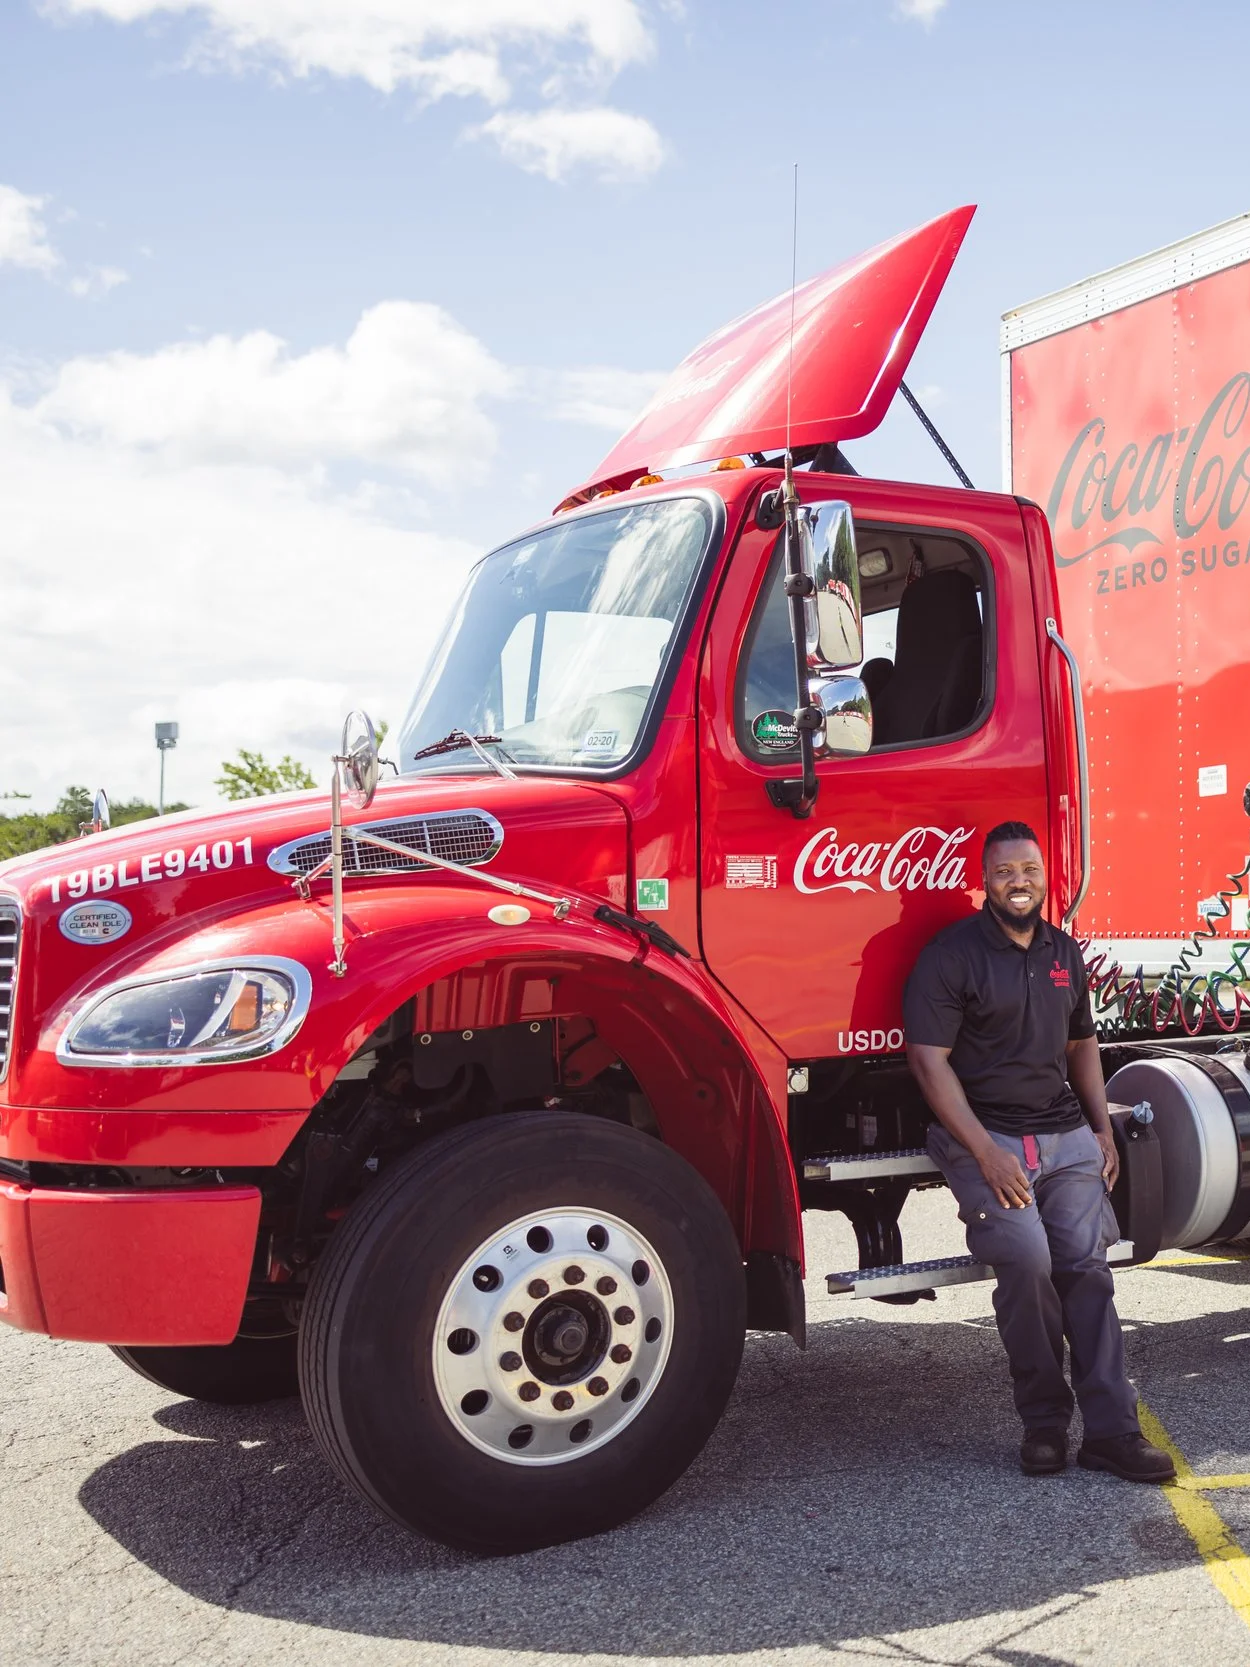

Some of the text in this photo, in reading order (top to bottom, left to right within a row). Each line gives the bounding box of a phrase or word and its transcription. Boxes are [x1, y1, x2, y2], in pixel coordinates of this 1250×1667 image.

[1096, 557, 1168, 595] ZERO
[42, 836, 254, 903] T9BLE9401
[793, 827, 976, 894] Coca-Cola
[73, 913, 118, 921] CERTIFIED
[838, 1028, 905, 1052] USDO
